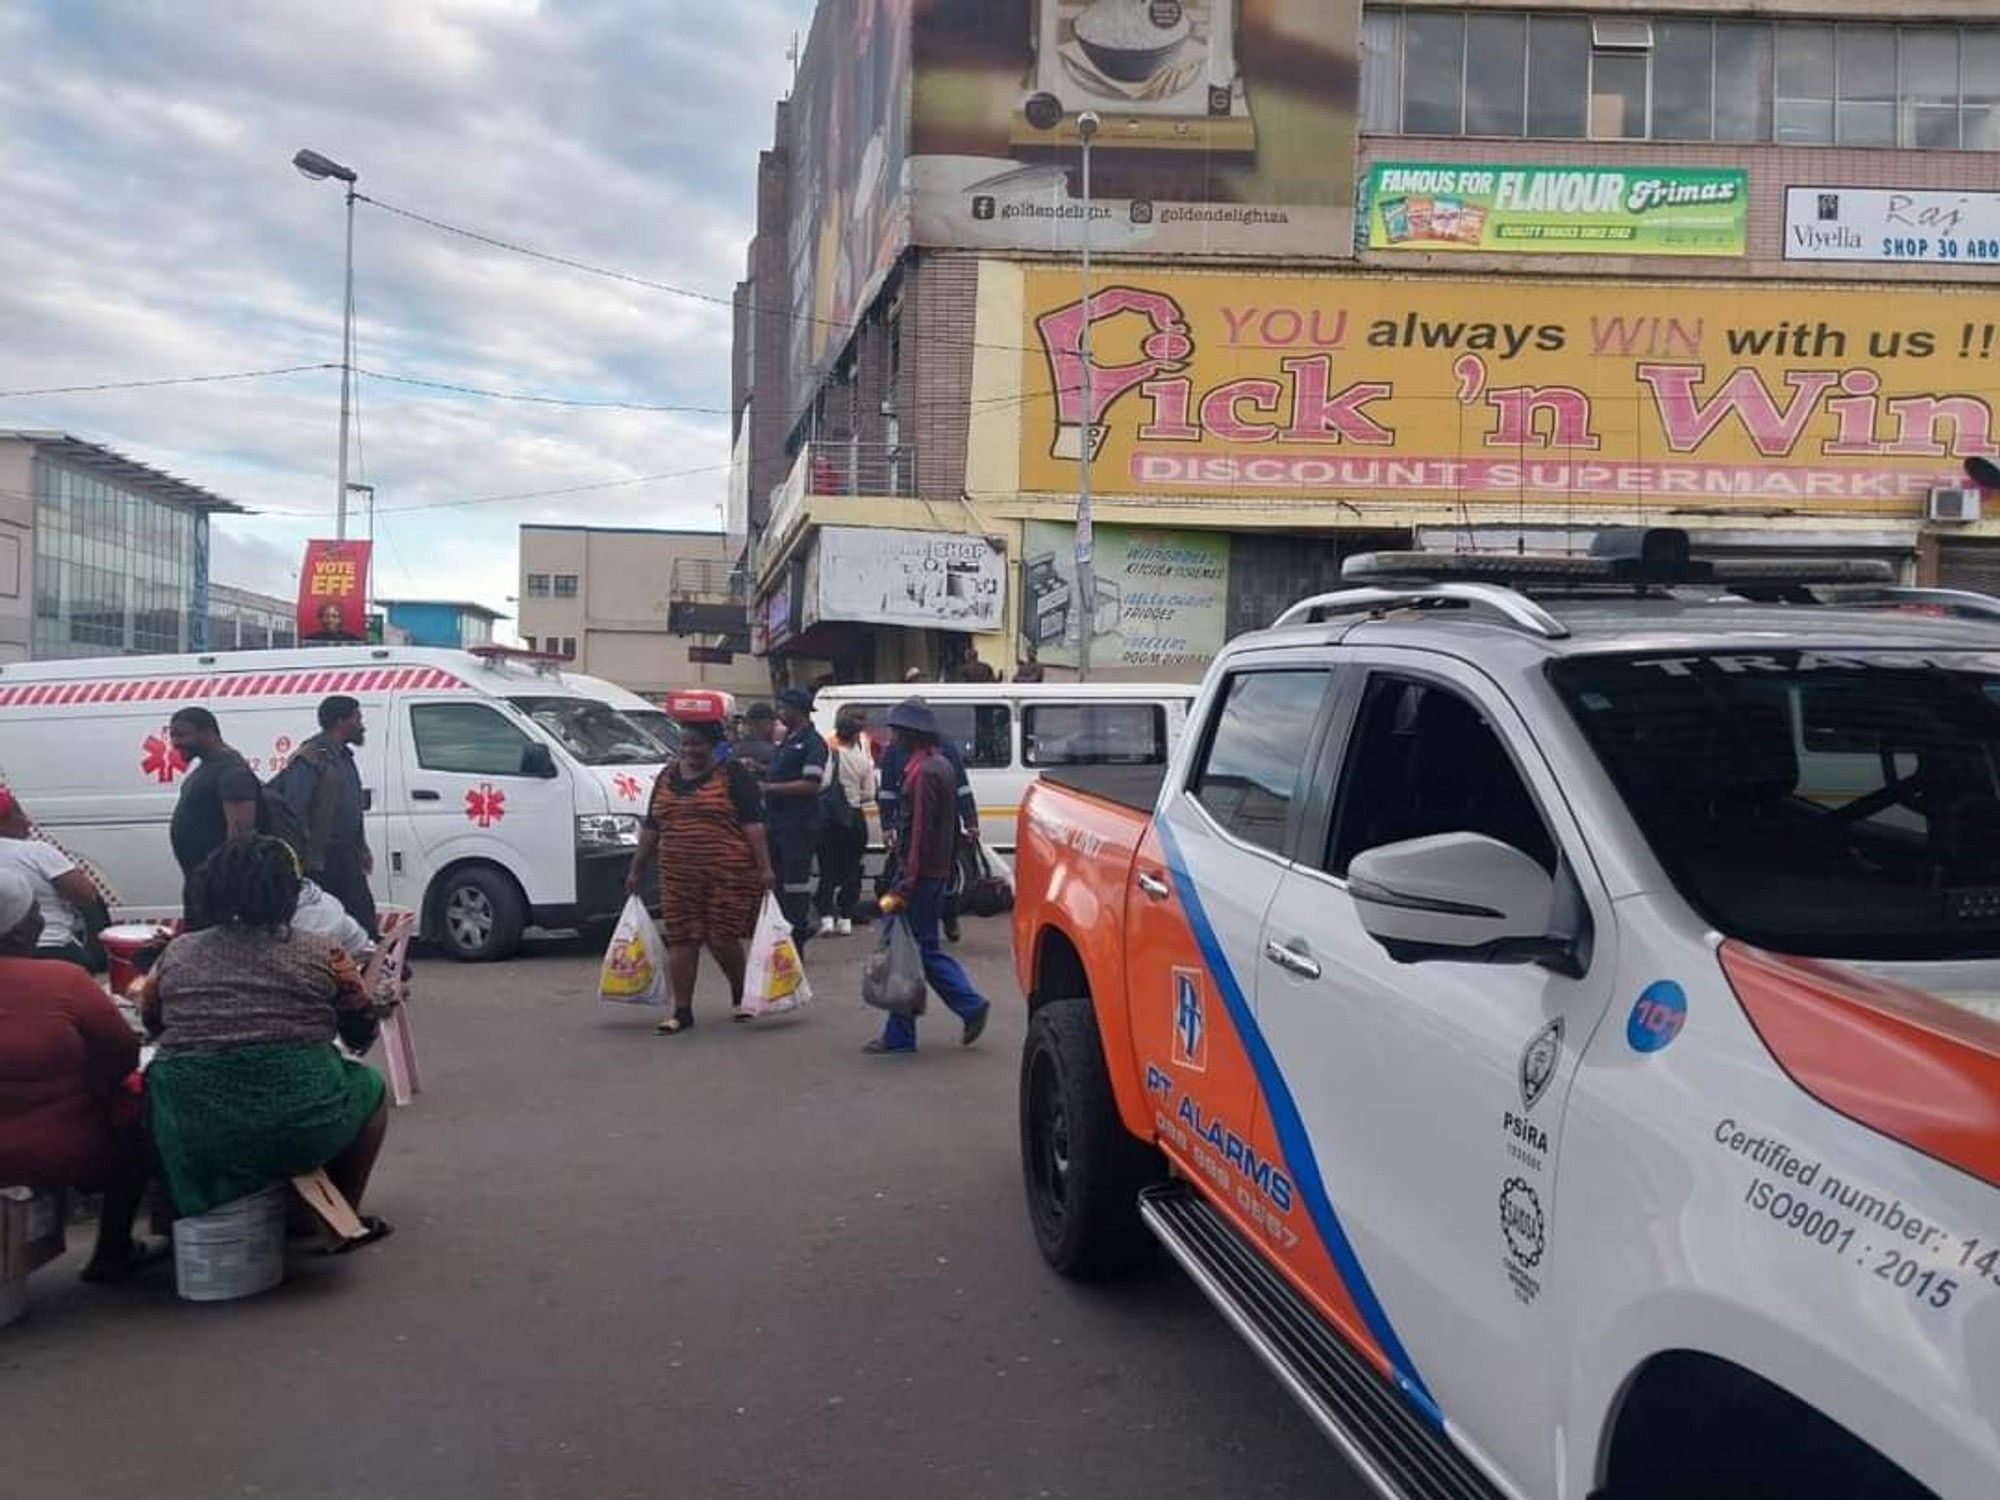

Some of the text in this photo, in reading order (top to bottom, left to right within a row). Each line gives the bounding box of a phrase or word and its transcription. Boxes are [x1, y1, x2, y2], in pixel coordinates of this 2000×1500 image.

[1380, 169, 1626, 212] FAMOUS FOR FLAVOUR
[1627, 179, 1735, 211] Frimax
[1794, 224, 1861, 251] Viyella
[1883, 238, 1928, 256] SHOP
[1937, 239, 1957, 257] 30
[1220, 307, 1348, 345] YOU
[1367, 312, 1566, 359] always
[1589, 316, 1704, 355] WIN
[1727, 321, 1846, 358] with
[1868, 329, 1936, 358] us
[1636, 362, 1999, 457] Win
[1141, 456, 1468, 488] DISCOUNT
[311, 575, 355, 596] EFF
[315, 562, 357, 575] VOTE
[1638, 1000, 1687, 1040] 101
[1146, 1065, 1173, 1098] PT
[1178, 1095, 1293, 1213] ALARMS
[1715, 1119, 1821, 1186] Certified
[1820, 1175, 1948, 1253] number:
[1745, 1178, 1856, 1254] ISO9001
[1873, 1250, 1958, 1308] 2015
